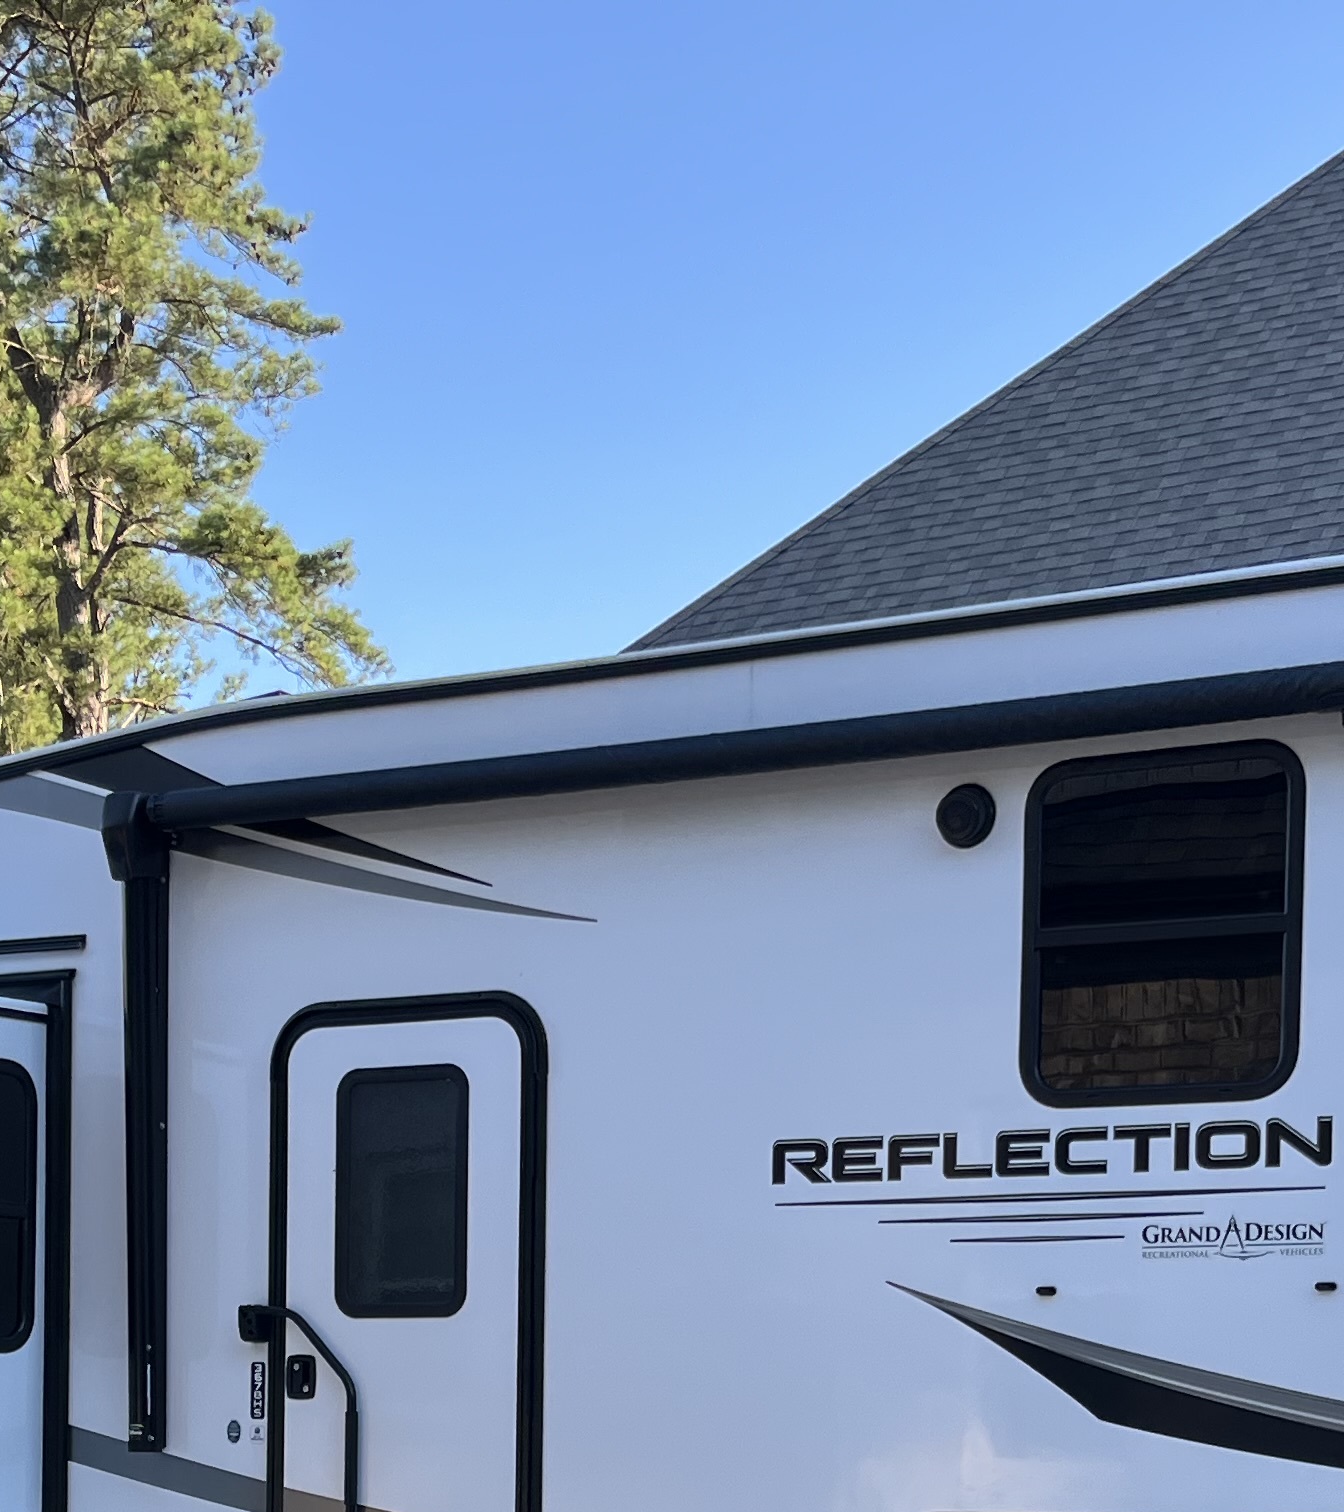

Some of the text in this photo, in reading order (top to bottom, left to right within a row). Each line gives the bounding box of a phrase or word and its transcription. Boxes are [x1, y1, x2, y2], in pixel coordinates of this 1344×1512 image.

[771, 1115, 1334, 1185] REFLECTION
[1141, 1222, 1325, 1244] GRAND DESIGN
[1141, 1247, 1324, 1260] RECREATIONAL VEHICLES
